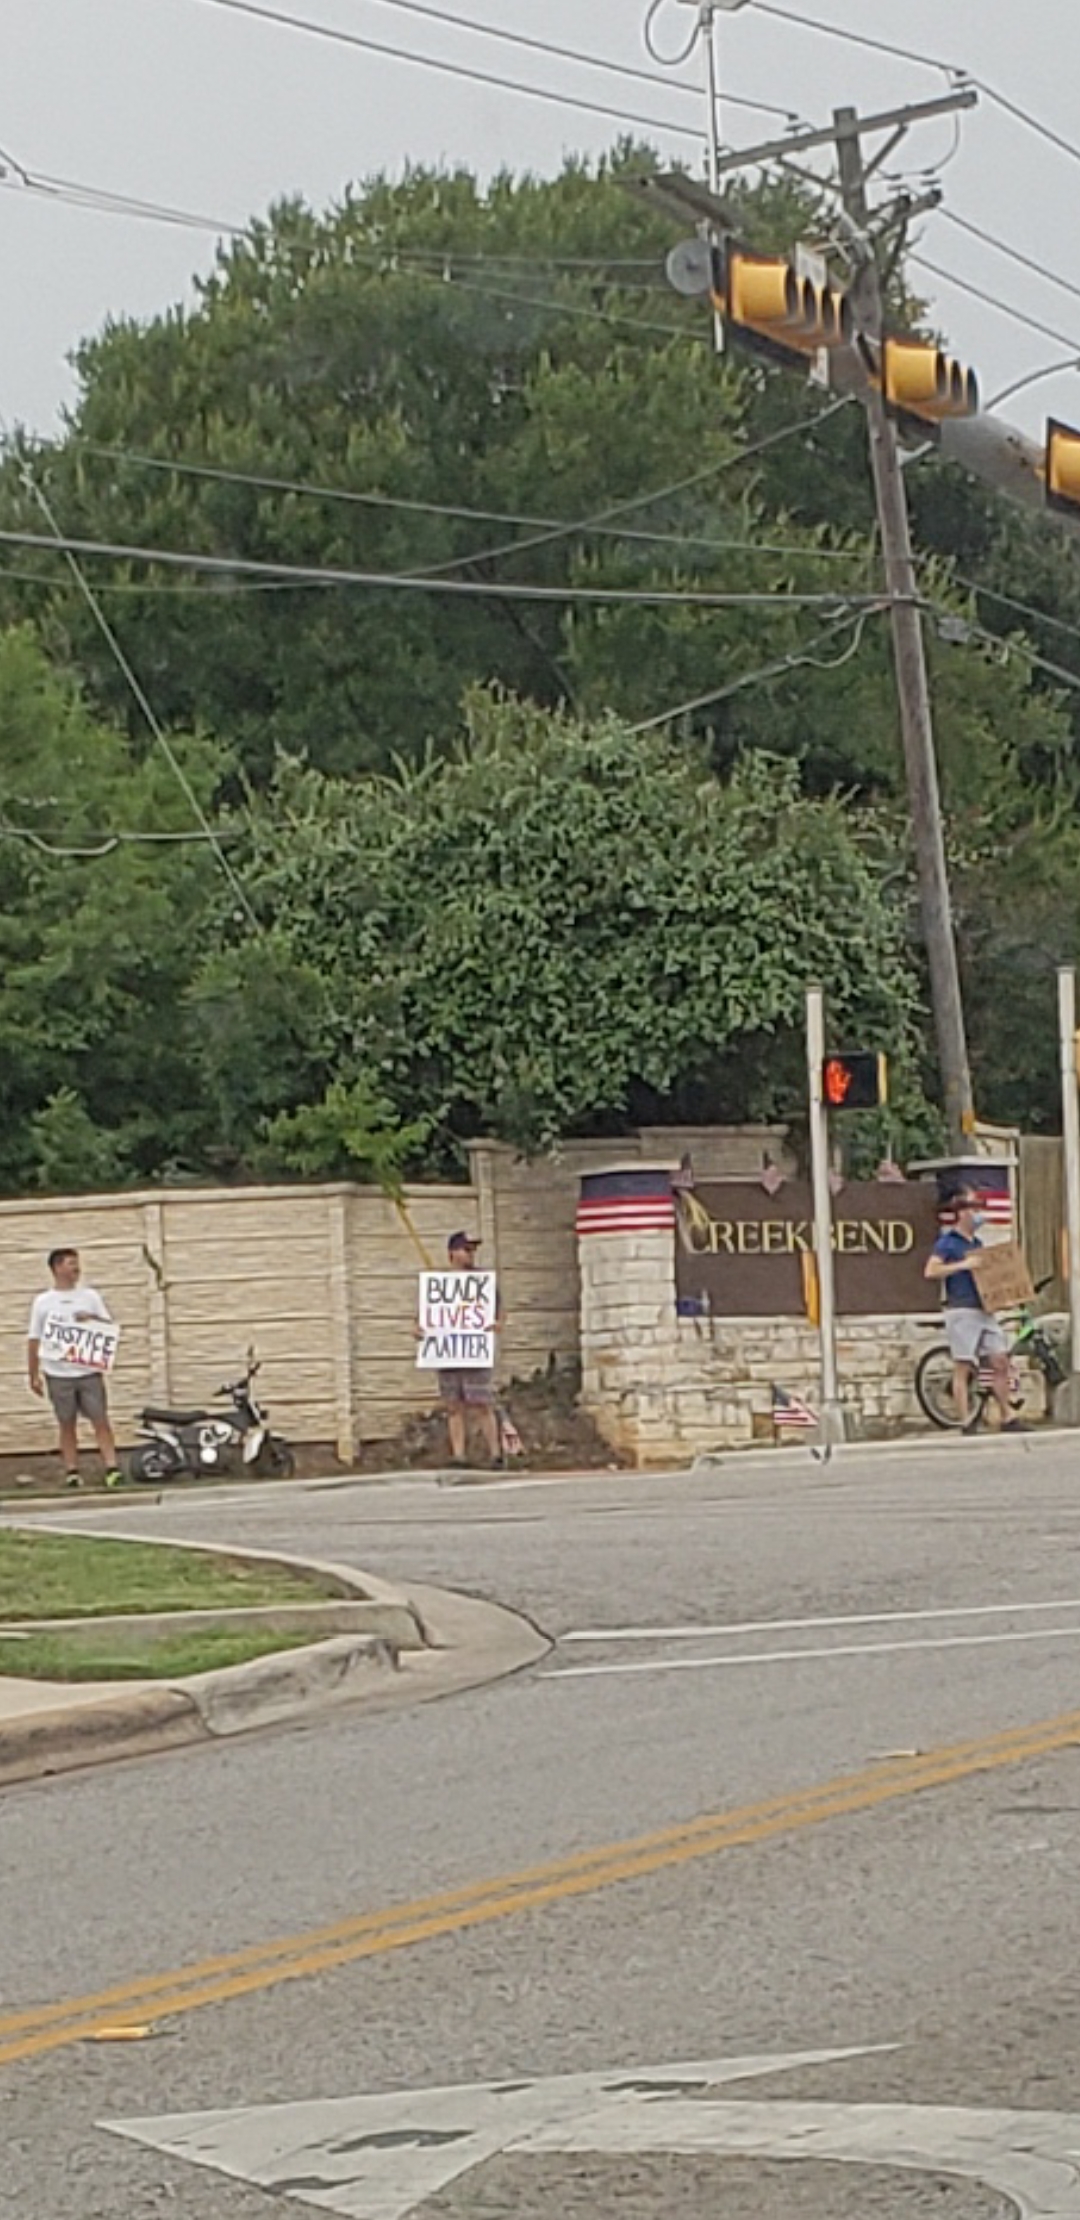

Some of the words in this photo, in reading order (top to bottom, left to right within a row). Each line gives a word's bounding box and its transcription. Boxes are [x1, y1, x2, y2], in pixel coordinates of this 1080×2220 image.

[426, 1274, 490, 1304] BLACK
[426, 1305, 485, 1330] LIVES
[44, 1323, 115, 1355] JUSTICE
[421, 1333, 490, 1359] MATTER
